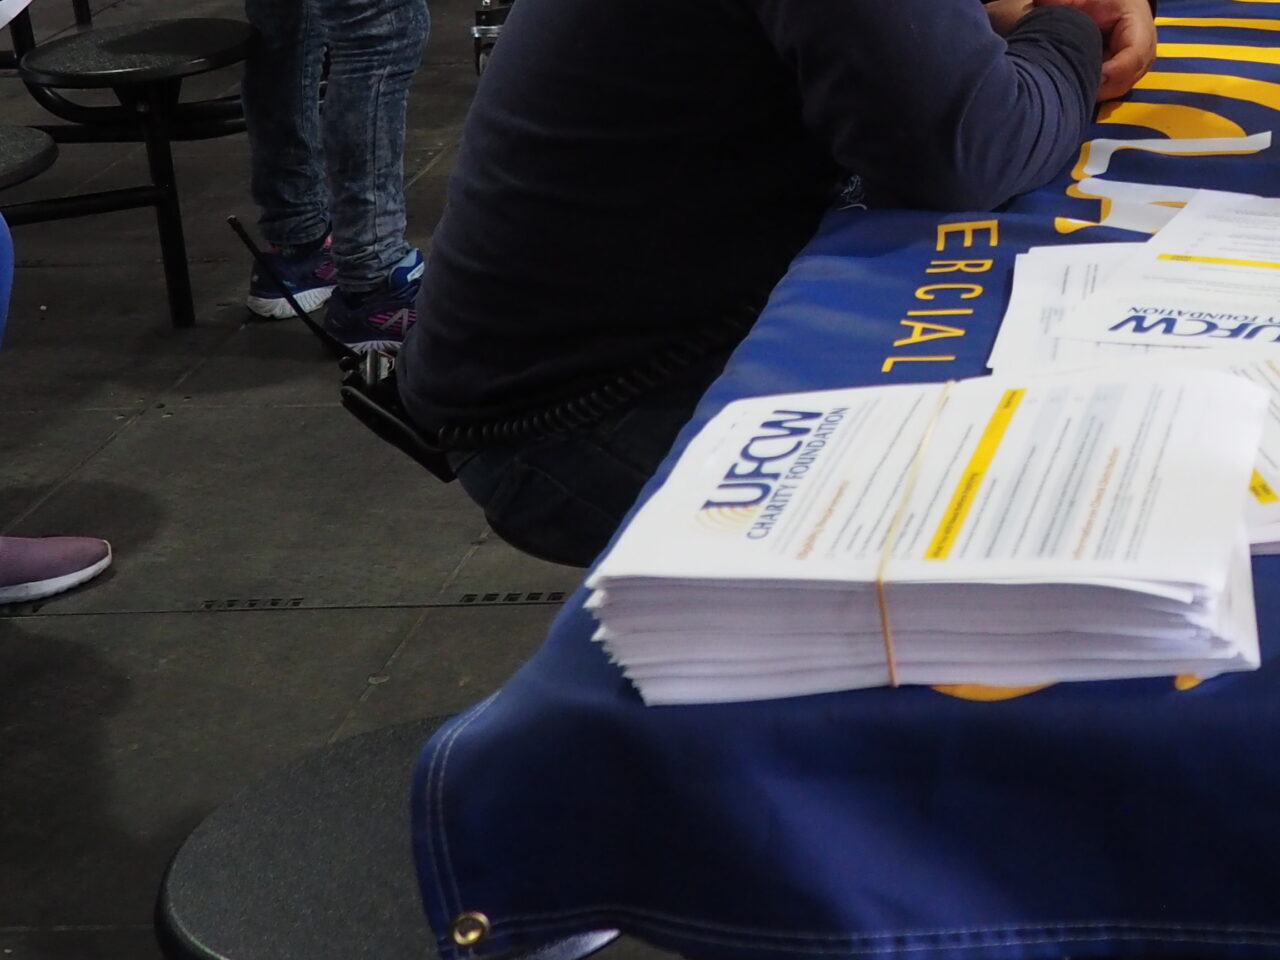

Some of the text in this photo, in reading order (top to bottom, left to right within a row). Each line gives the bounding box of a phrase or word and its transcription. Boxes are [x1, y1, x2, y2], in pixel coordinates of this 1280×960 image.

[881, 219, 998, 373] ERCIAL
[1128, 306, 1261, 325] FOUNDATION
[700, 410, 823, 511] UFCW
[746, 484, 799, 539] CHARITY
[784, 407, 850, 480] FOUNDATION
